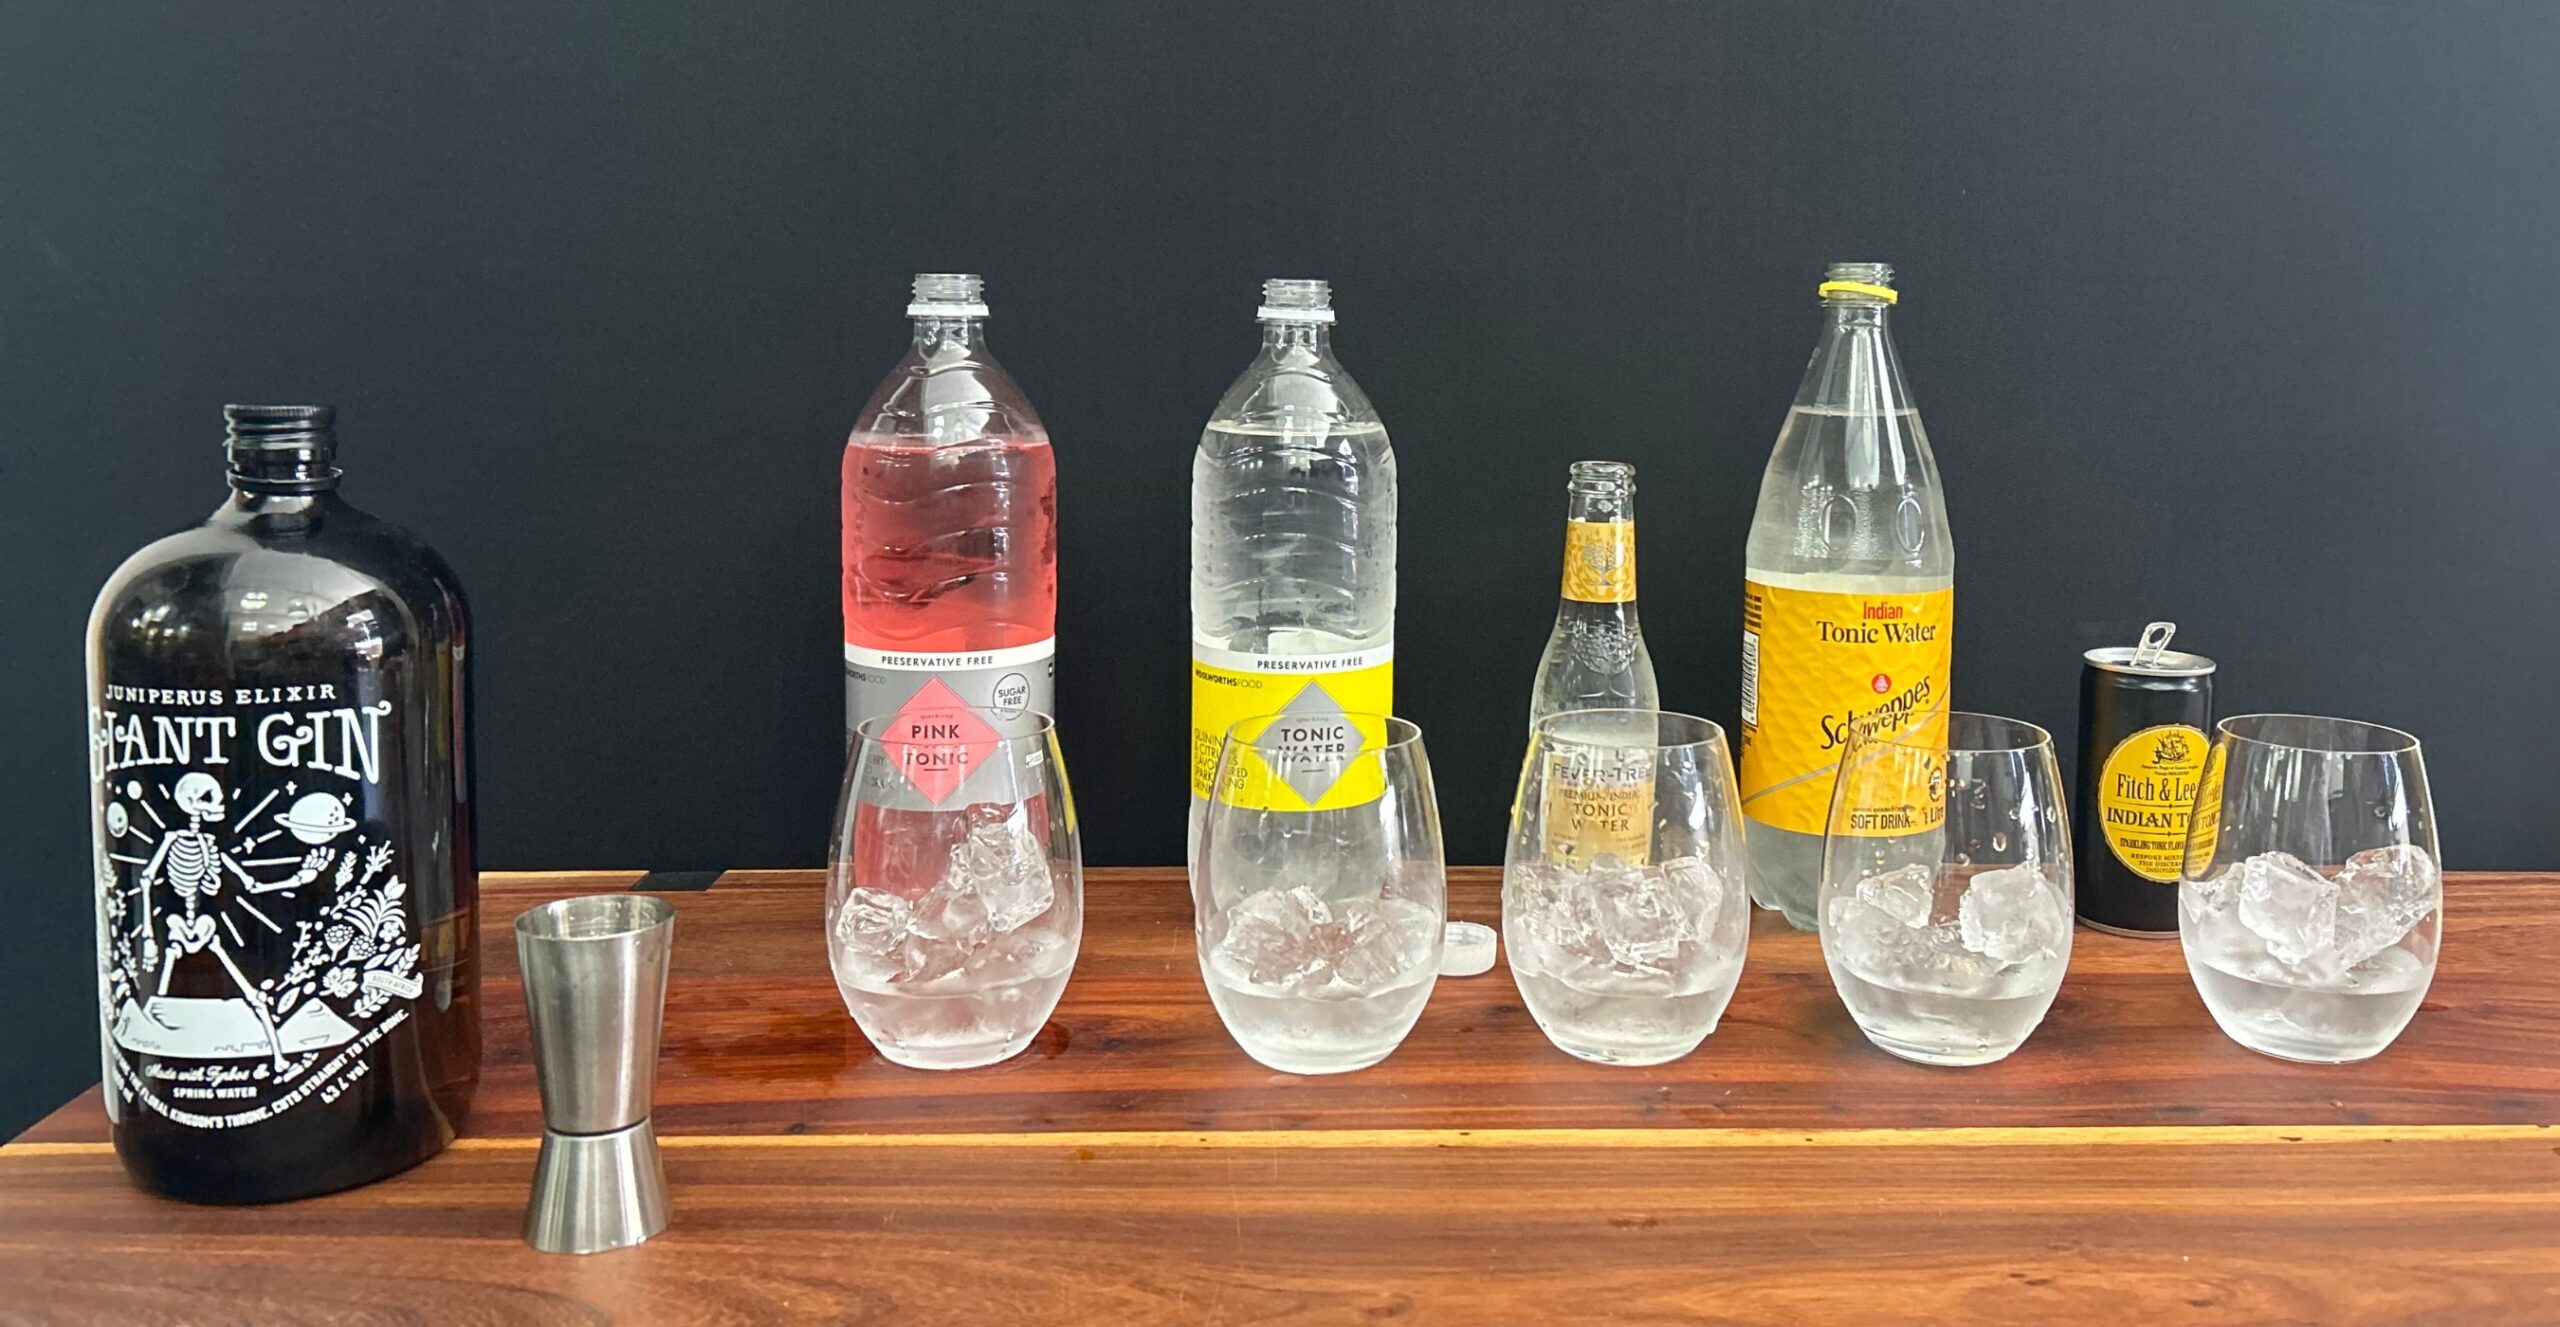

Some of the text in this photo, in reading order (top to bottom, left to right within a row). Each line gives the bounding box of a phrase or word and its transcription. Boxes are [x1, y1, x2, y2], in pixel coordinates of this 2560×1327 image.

[1863, 601, 1903, 620] Indian
[1816, 621, 1936, 644] Tonic Water
[881, 655, 994, 666] PRESERVATIVE FREE
[1257, 657, 1363, 670] PRESERVATIVE FREE
[105, 684, 337, 706] JUNIPERUS ELIXIR
[998, 686, 1026, 698] SUGAR
[1003, 696, 1022, 706] FREE
[1820, 676, 1930, 750] Schweppes
[911, 724, 960, 739] PINK
[1281, 726, 1344, 742] TONIC
[257, 700, 392, 784] GIN
[906, 751, 970, 766] TONIC
[1278, 743, 1345, 762] WATER
[1552, 762, 1651, 783] FEVER-TREE
[2116, 773, 2155, 801] Fitch
[2159, 778, 2171, 801] &
[2174, 777, 2198, 801] Lee
[1573, 802, 1628, 817] TONIC
[2107, 807, 2173, 828] INDIAN
[1571, 818, 1629, 832] WTER
[1850, 812, 1911, 830] SOFT DRINK
[345, 1042, 363, 1058] TO
[360, 1027, 383, 1048] THE
[346, 1059, 370, 1082] vol
[173, 1086, 258, 1099] SPRING WATER
